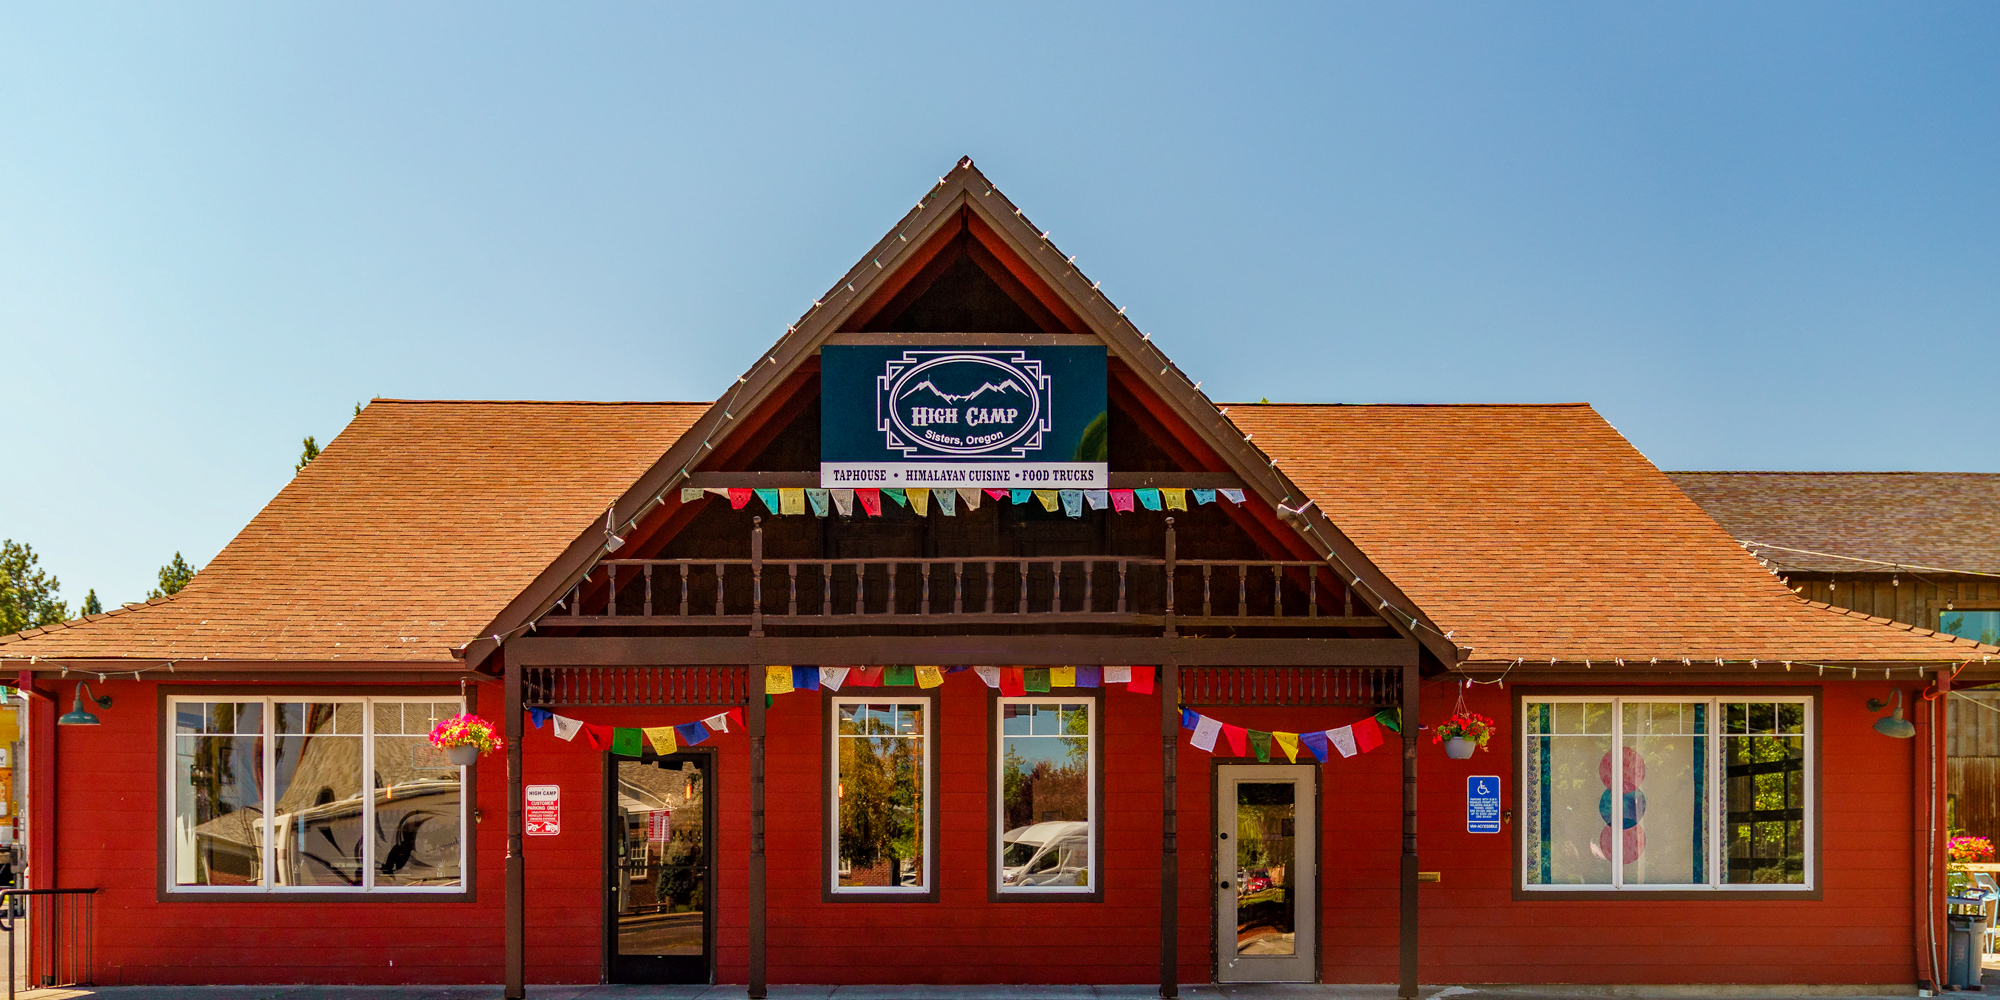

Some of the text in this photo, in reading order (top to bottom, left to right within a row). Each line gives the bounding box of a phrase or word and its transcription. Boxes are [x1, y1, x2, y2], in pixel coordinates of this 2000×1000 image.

[924, 429, 1004, 446] Sisters, Oregon
[833, 469, 1094, 482] TAPHOUSE HIMALAYAN CUISINE FOOD TRUCKS
